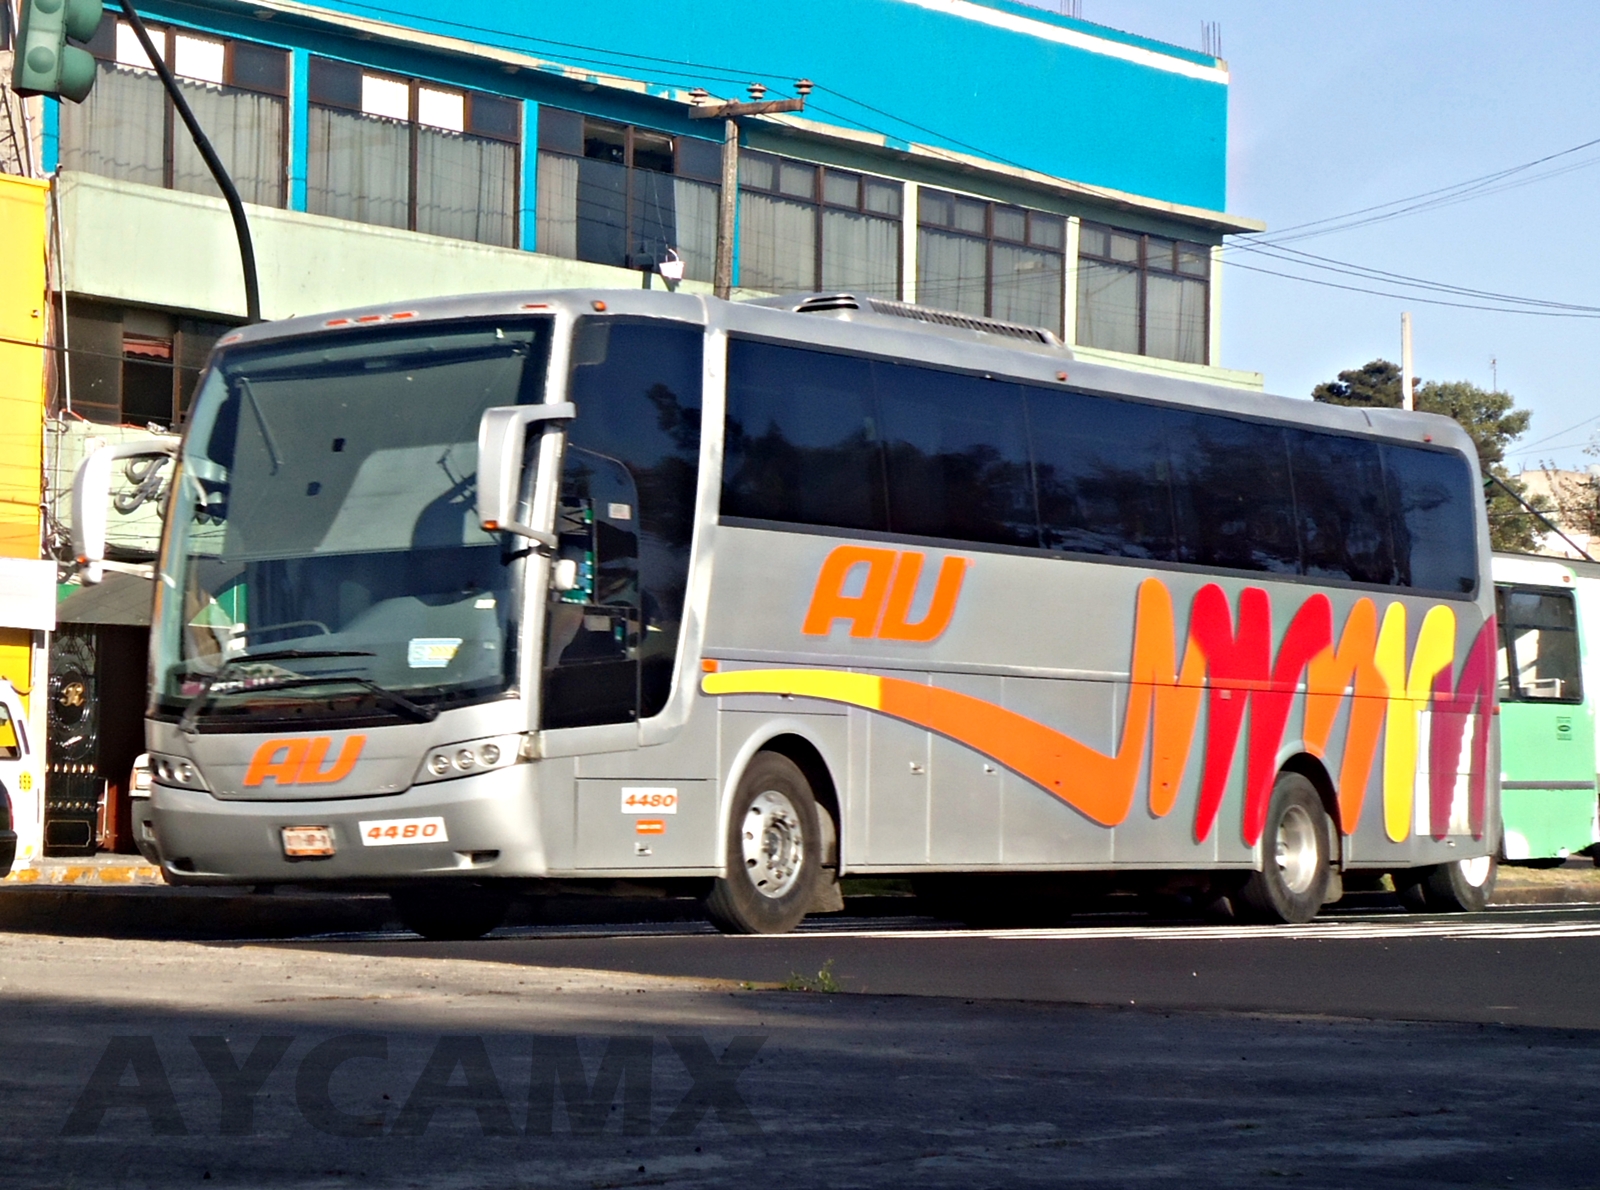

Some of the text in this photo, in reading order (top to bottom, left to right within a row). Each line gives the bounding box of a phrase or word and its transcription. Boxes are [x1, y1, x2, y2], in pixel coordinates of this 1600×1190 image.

[802, 544, 968, 643] AU
[244, 734, 367, 787] AU
[625, 793, 675, 808] 4480
[367, 822, 438, 840] 4480
